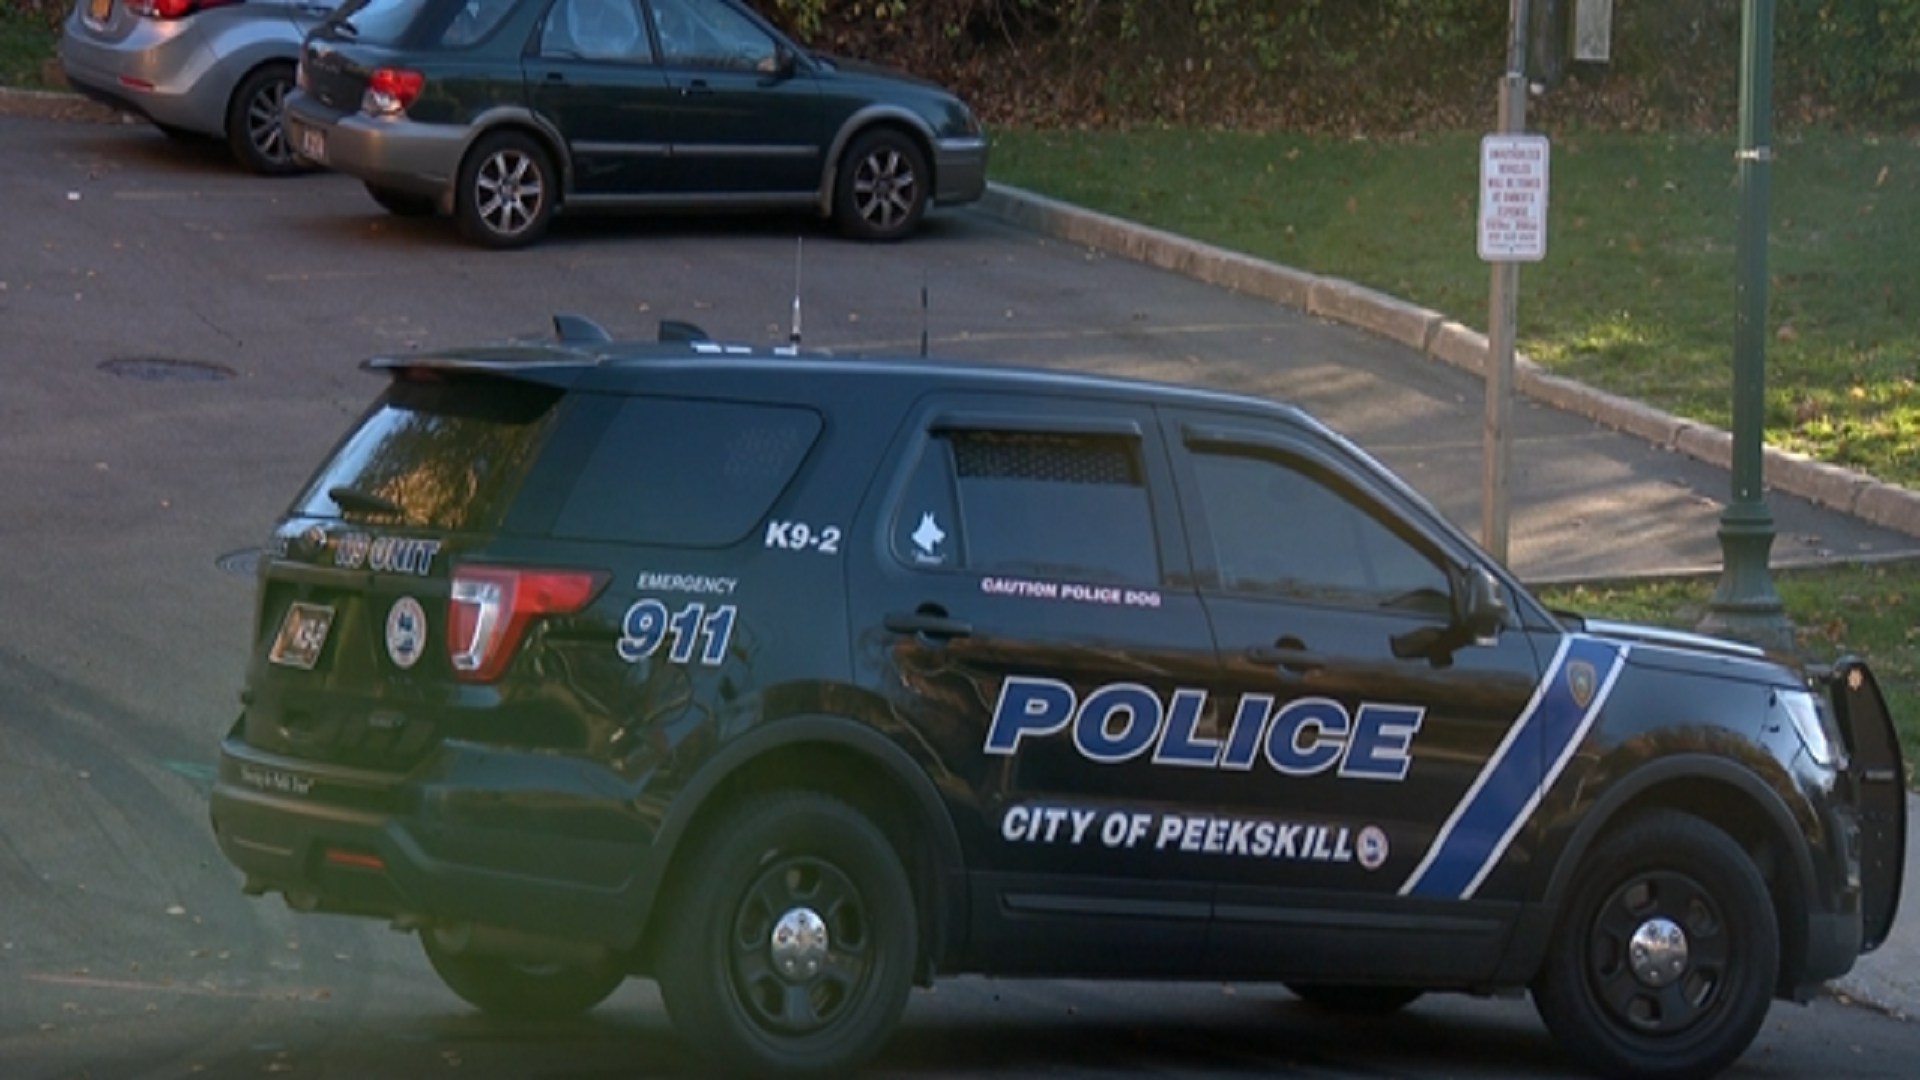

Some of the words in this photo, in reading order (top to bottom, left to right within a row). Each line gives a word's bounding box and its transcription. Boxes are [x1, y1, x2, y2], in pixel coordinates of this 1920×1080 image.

[369, 536, 441, 576] UNIT
[765, 520, 842, 554] K9-2
[637, 571, 738, 594] EMERGENCY
[981, 576, 1057, 598] CAUTION
[1061, 583, 1122, 605] POLICE
[1125, 589, 1162, 608] DOG
[617, 598, 737, 666] 911
[984, 675, 1426, 781] POLICE
[1001, 806, 1096, 845] CITY
[1101, 812, 1152, 849] OF
[1156, 815, 1353, 863] PEEKSKILL
